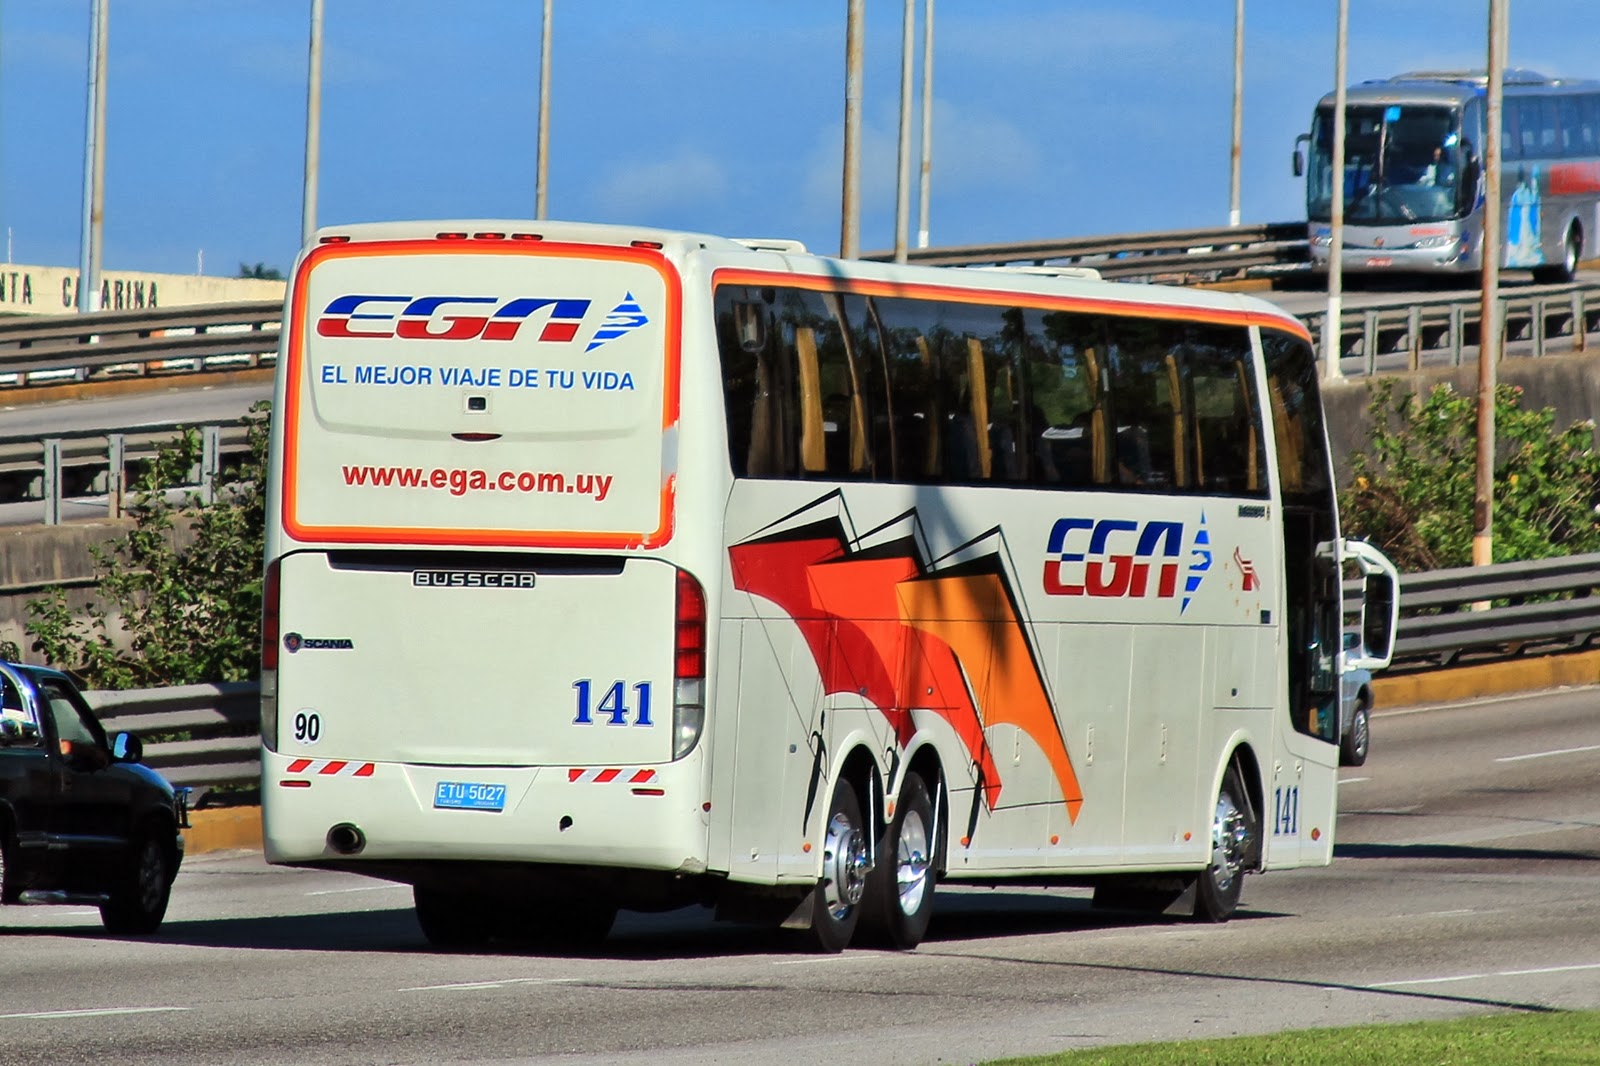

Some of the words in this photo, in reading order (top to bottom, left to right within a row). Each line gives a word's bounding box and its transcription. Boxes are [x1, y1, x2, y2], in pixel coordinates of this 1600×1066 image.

[316, 294, 592, 343] EGA
[321, 365, 348, 384] EL
[354, 366, 433, 386] MEJOR
[439, 367, 502, 387] VIAJE
[508, 369, 539, 388] DE
[545, 370, 575, 390] TU
[582, 371, 635, 391] VIDA
[342, 464, 615, 502] www.ega.com.uy
[1043, 517, 1184, 598] EGA
[415, 572, 535, 588] BUSSCAR
[304, 638, 354, 649] SCANIA
[571, 678, 655, 728] 141
[294, 712, 320, 742] 90
[438, 783, 465, 799] ETU
[468, 785, 505, 801] 5027
[1274, 785, 1298, 836] 141
